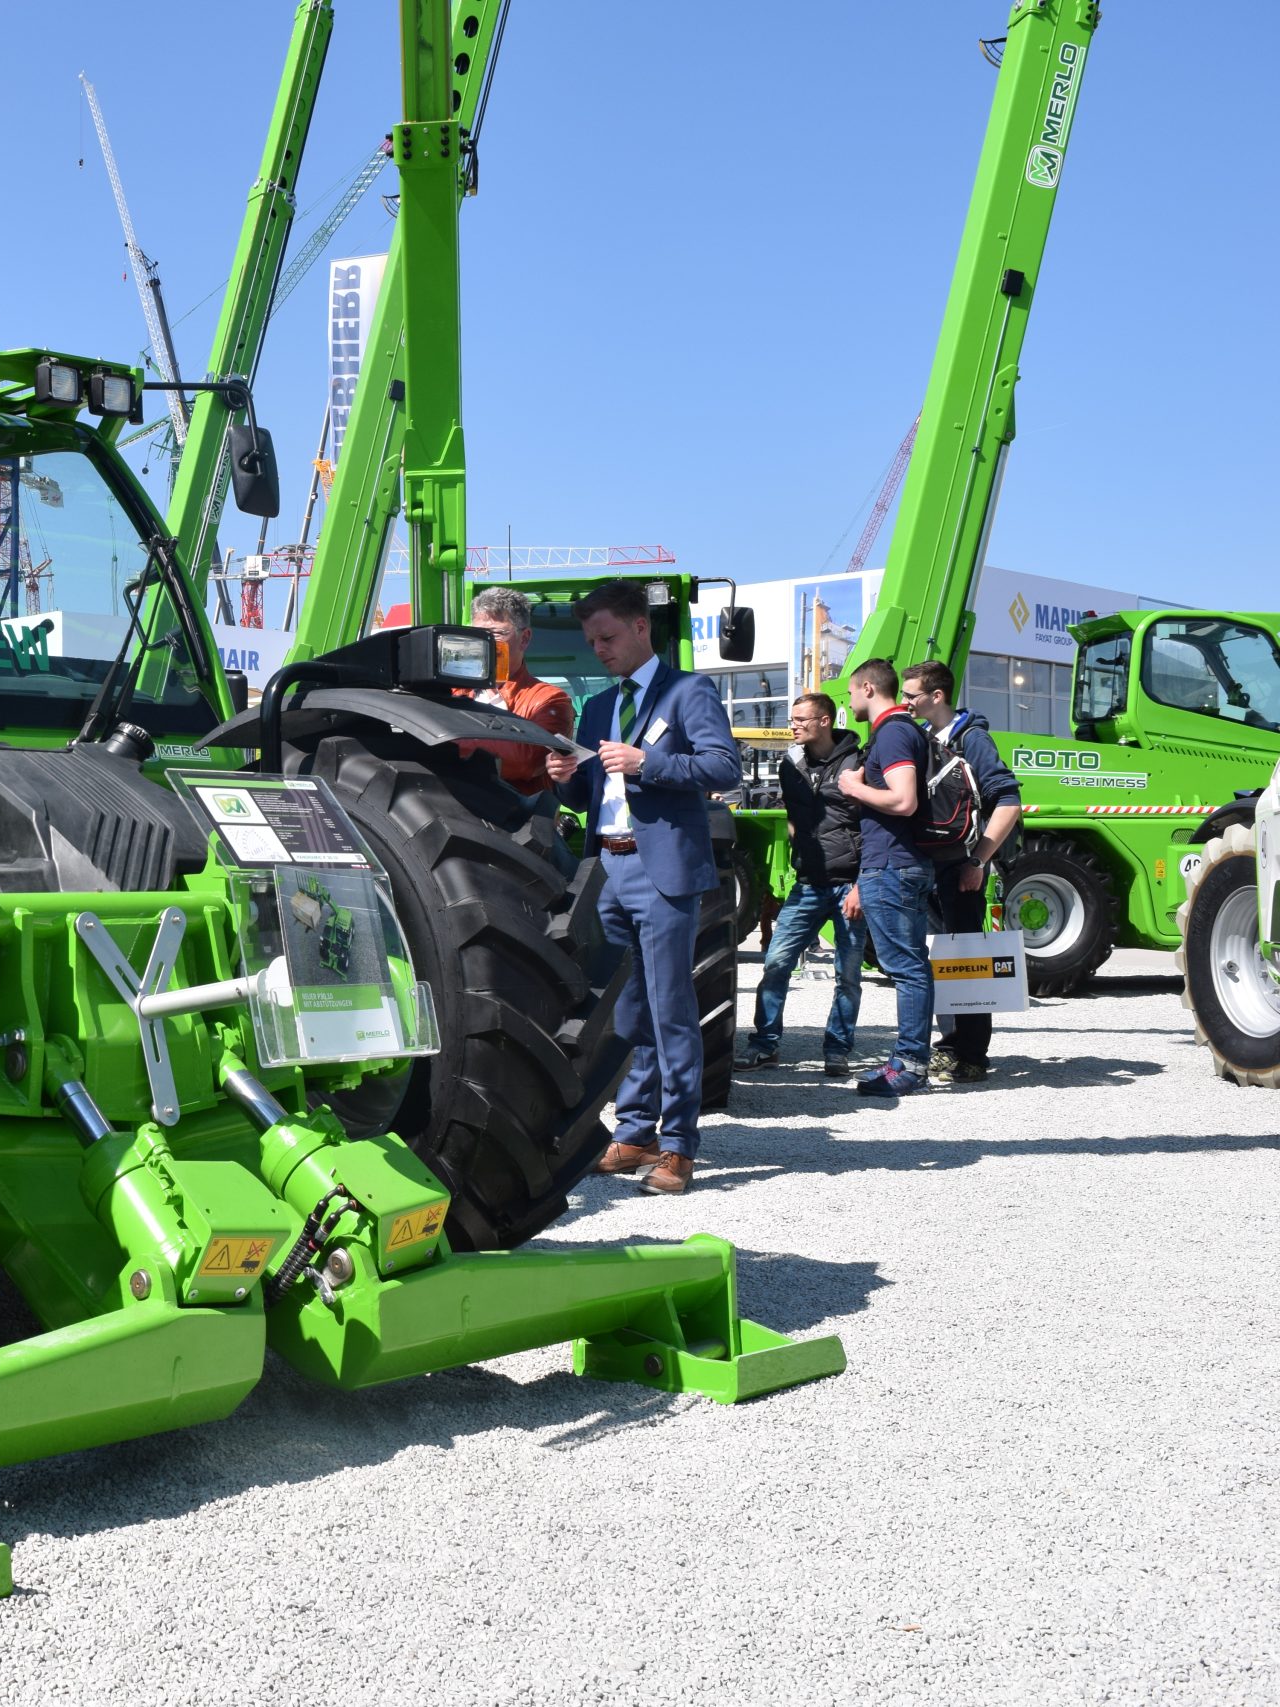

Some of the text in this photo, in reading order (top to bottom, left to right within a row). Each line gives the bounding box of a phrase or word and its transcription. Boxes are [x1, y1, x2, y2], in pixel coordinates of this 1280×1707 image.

[1040, 42, 1079, 145] MERLO
[1035, 633, 1073, 646] FAYAT GROUP
[160, 743, 210, 758] MERLO
[1013, 749, 1101, 770] ROTO
[938, 961, 1013, 974] ZEPPELIN CAT
